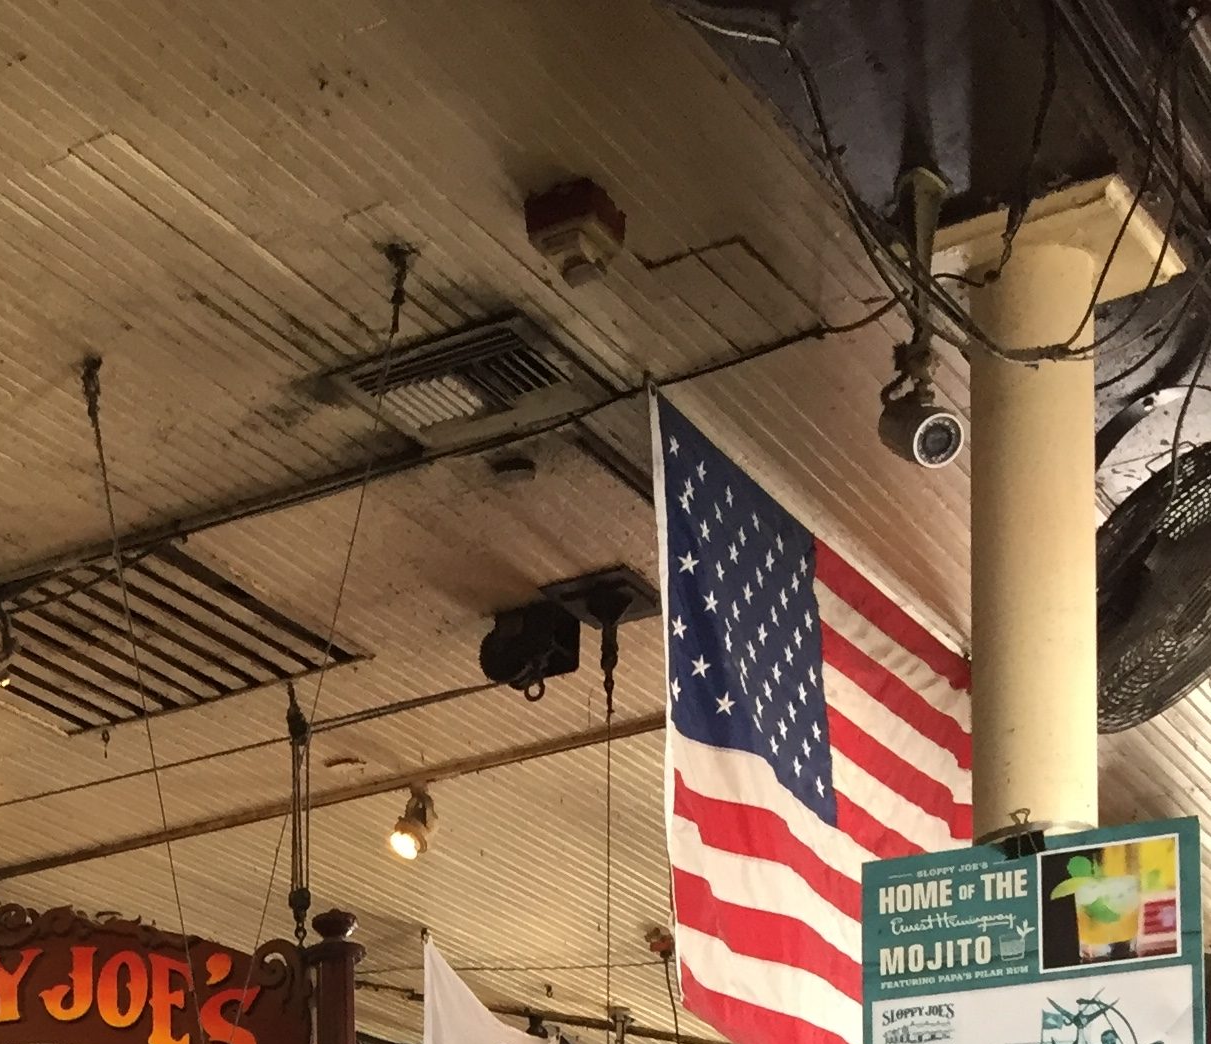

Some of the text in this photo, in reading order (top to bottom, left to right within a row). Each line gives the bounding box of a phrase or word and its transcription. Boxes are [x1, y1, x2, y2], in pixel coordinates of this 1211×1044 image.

[917, 862, 988, 878] SLOPPY JOE'S
[879, 869, 1027, 914] HOME OF THE
[880, 936, 991, 976] MOJITO
[881, 966, 1028, 989] FEATURING PAPA'S PILAR RUM
[882, 1006, 924, 1026] SLOPPY
